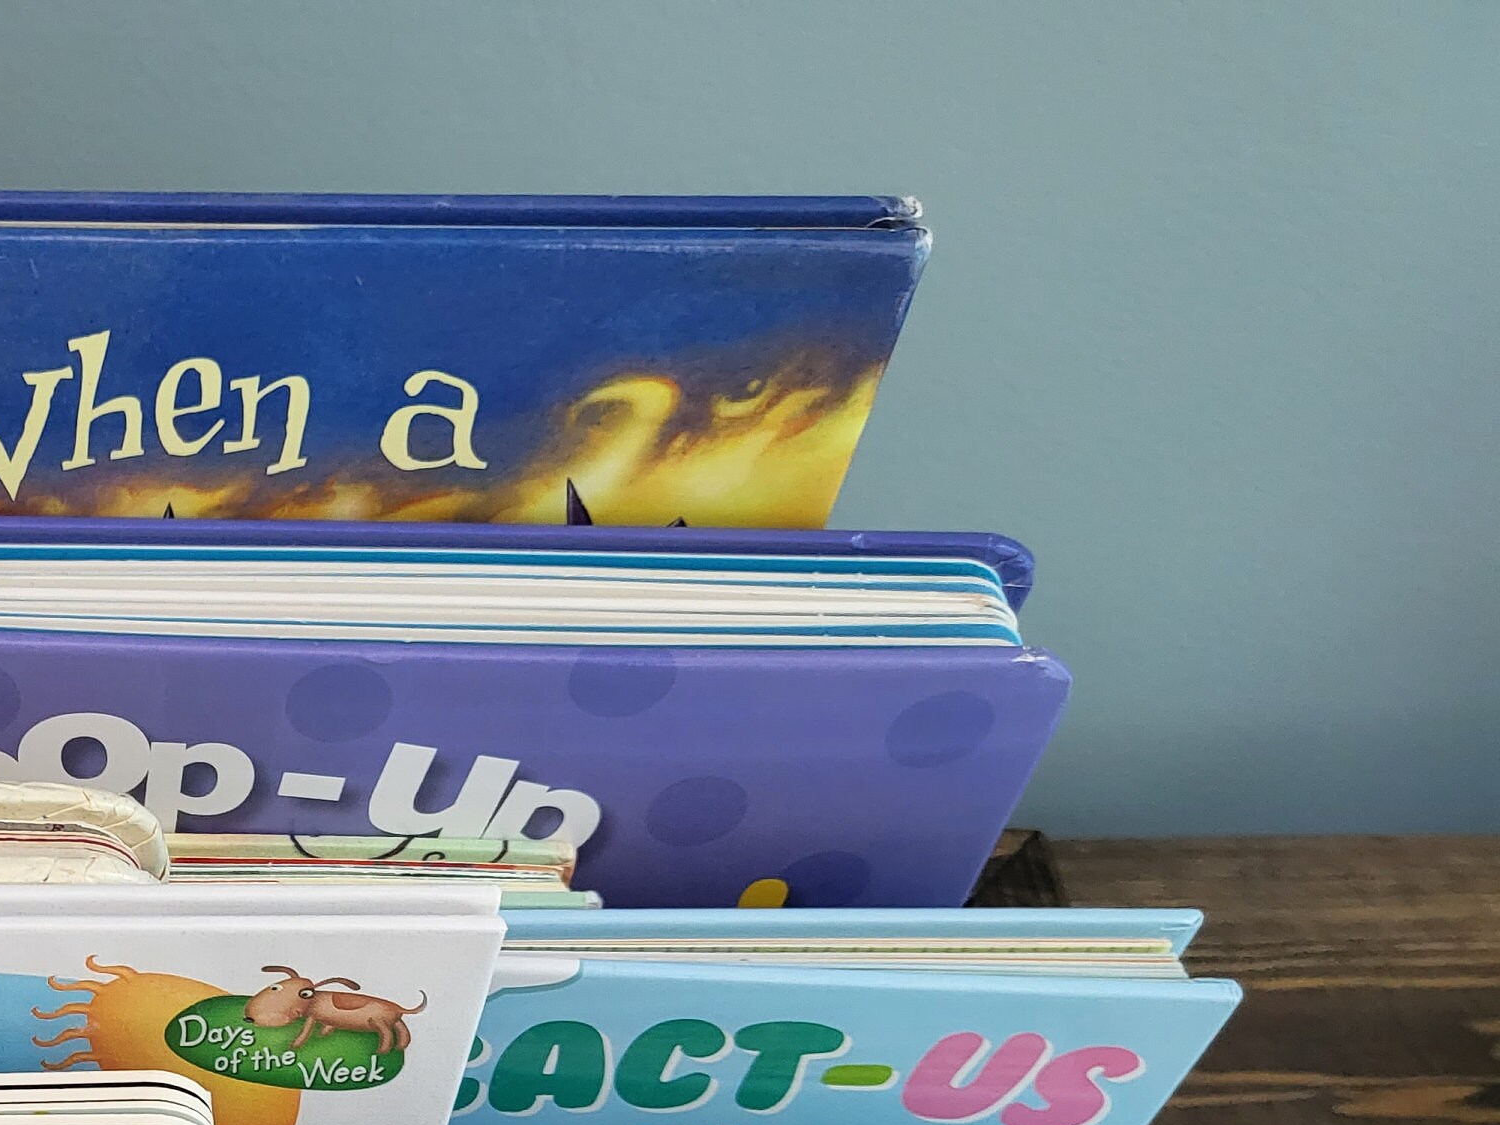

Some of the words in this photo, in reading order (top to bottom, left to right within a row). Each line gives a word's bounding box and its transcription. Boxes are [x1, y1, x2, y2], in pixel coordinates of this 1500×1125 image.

[379, 370, 488, 472] a
[178, 1014, 256, 1050] Days
[214, 1048, 248, 1074] of
[251, 1047, 297, 1072] the
[297, 1055, 386, 1088] Week
